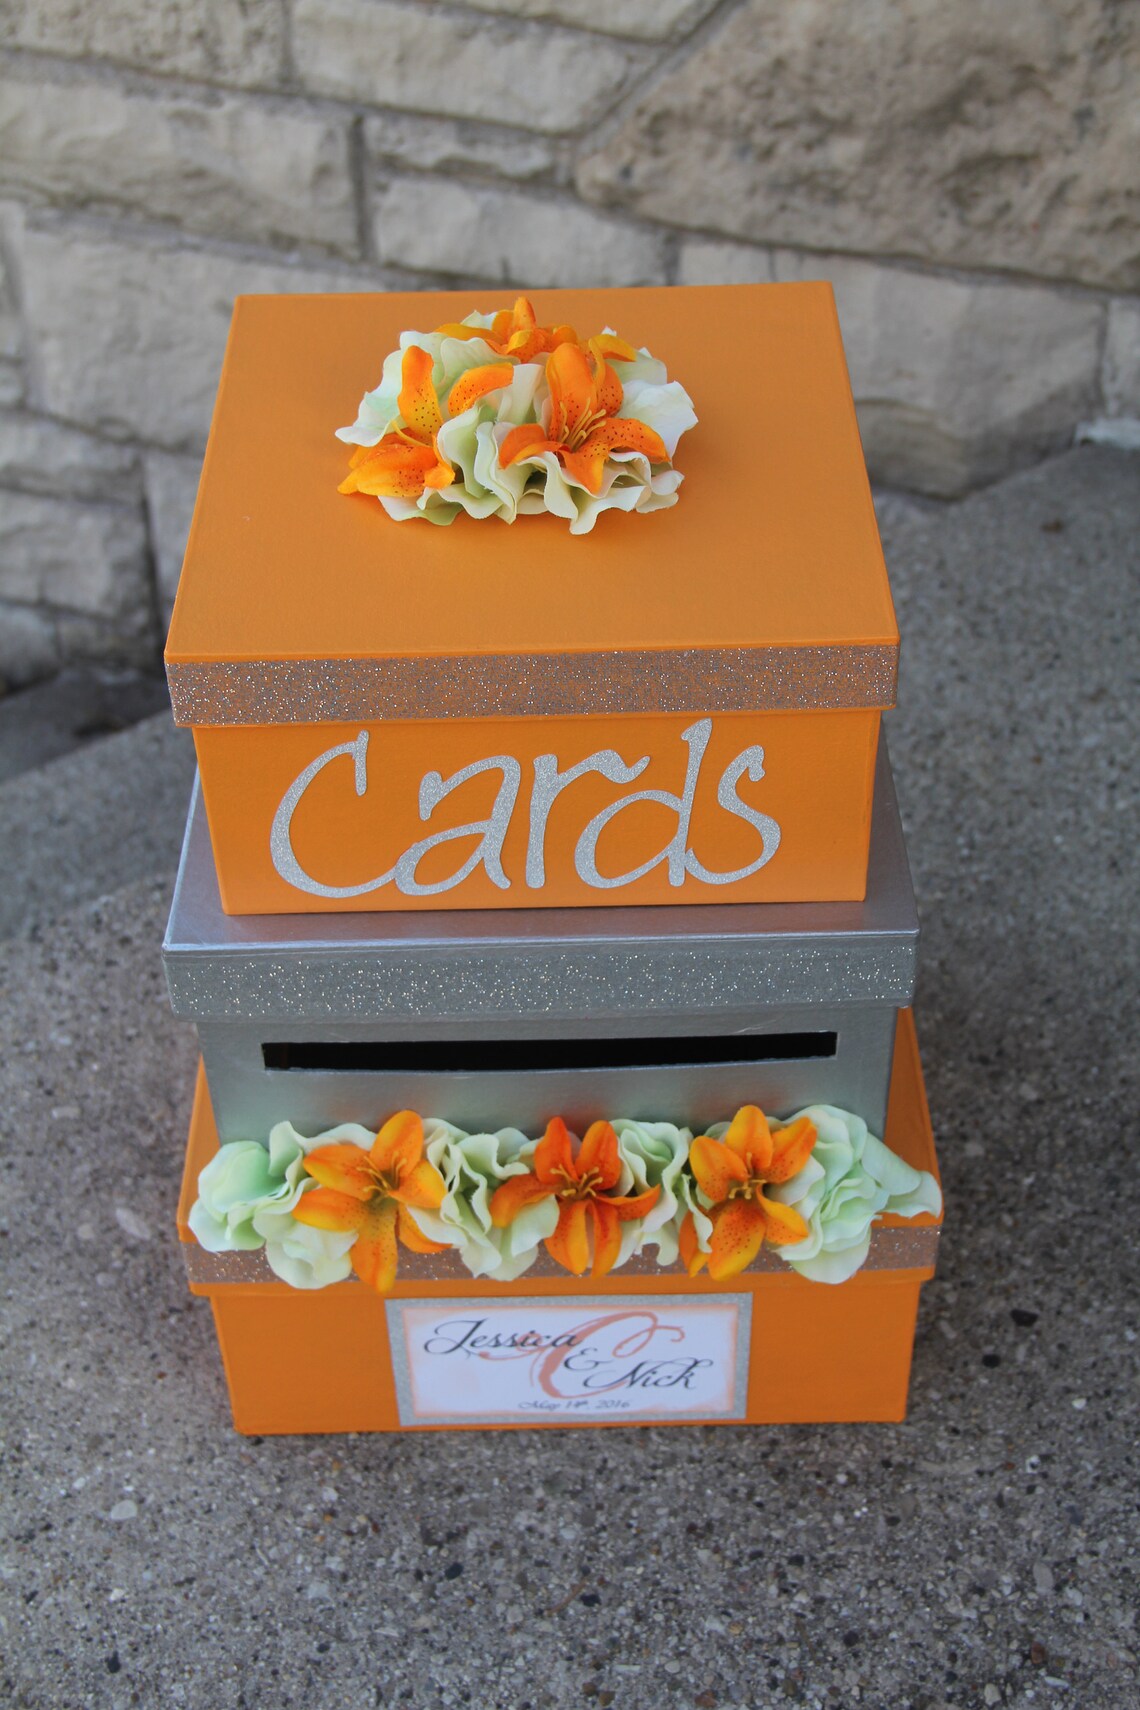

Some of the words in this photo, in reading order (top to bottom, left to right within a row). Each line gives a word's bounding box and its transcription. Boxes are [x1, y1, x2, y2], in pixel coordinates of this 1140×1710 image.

[270, 718, 781, 898] Cards
[424, 1318, 582, 1359] Jessica
[563, 1348, 606, 1372] &
[583, 1357, 714, 1390] Nick
[518, 1400, 560, 1411] May
[595, 1399, 631, 1409] 2016
